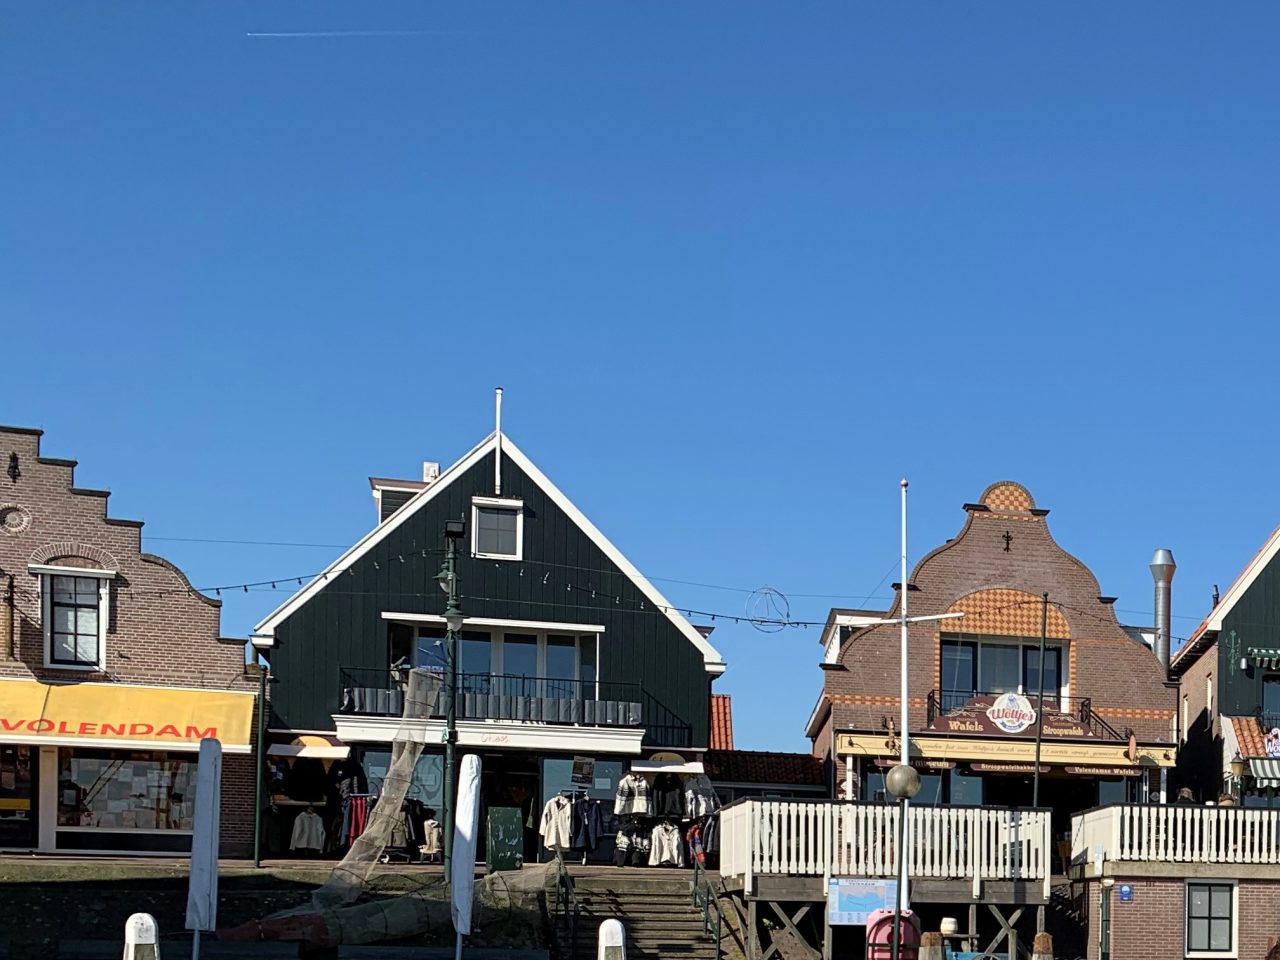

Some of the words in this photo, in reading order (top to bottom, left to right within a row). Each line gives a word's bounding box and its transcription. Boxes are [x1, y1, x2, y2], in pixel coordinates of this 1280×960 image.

[1, 719, 218, 738] VOLENDAM
[948, 720, 984, 732] Wafels
[1043, 725, 1084, 736] Stroopwafels
